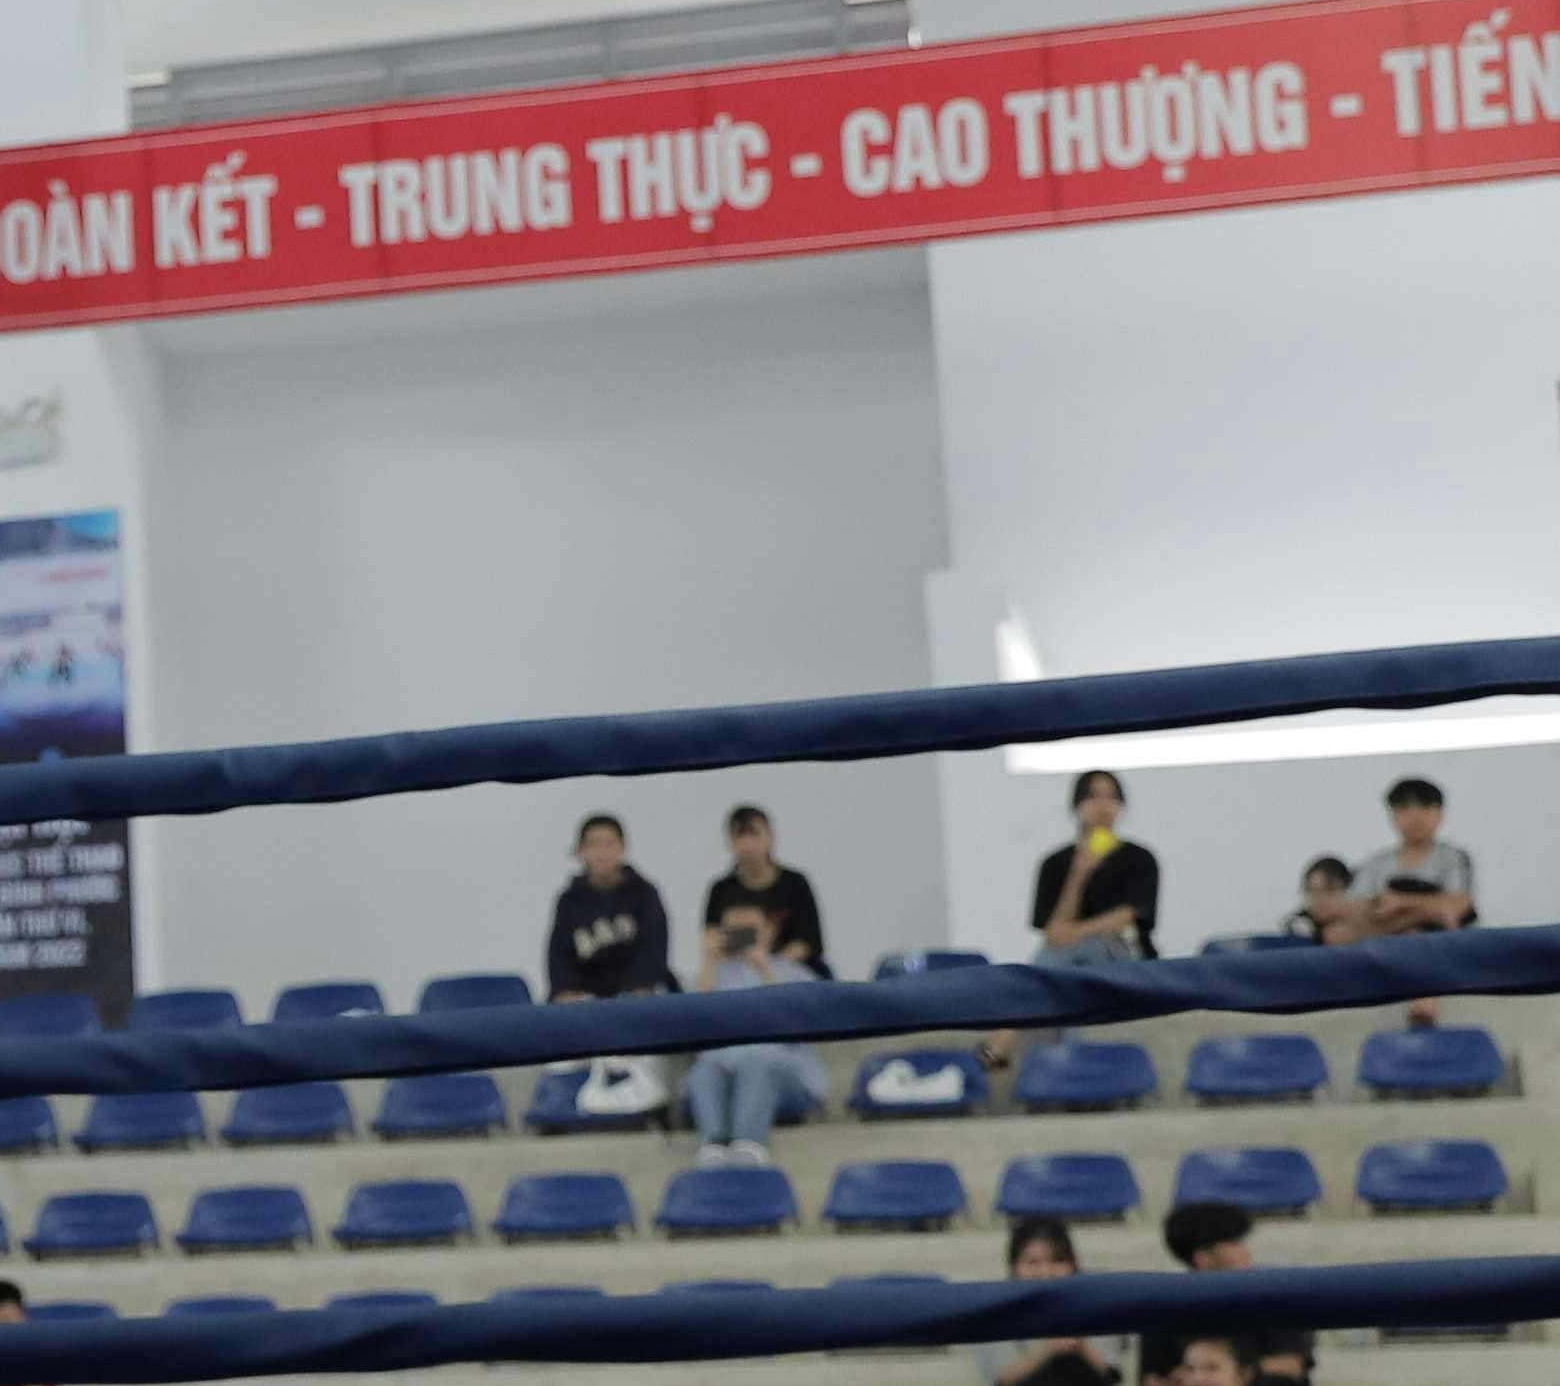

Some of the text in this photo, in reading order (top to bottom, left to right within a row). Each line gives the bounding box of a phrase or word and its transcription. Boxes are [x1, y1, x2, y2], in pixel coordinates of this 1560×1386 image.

[152, 150, 278, 269] KẾT
[338, 142, 572, 248] TRUNG
[586, 112, 771, 233] THỰC
[840, 97, 990, 198] CAO
[1003, 60, 1309, 182] THƯỢNG
[1379, 7, 1560, 139] TIẾN
